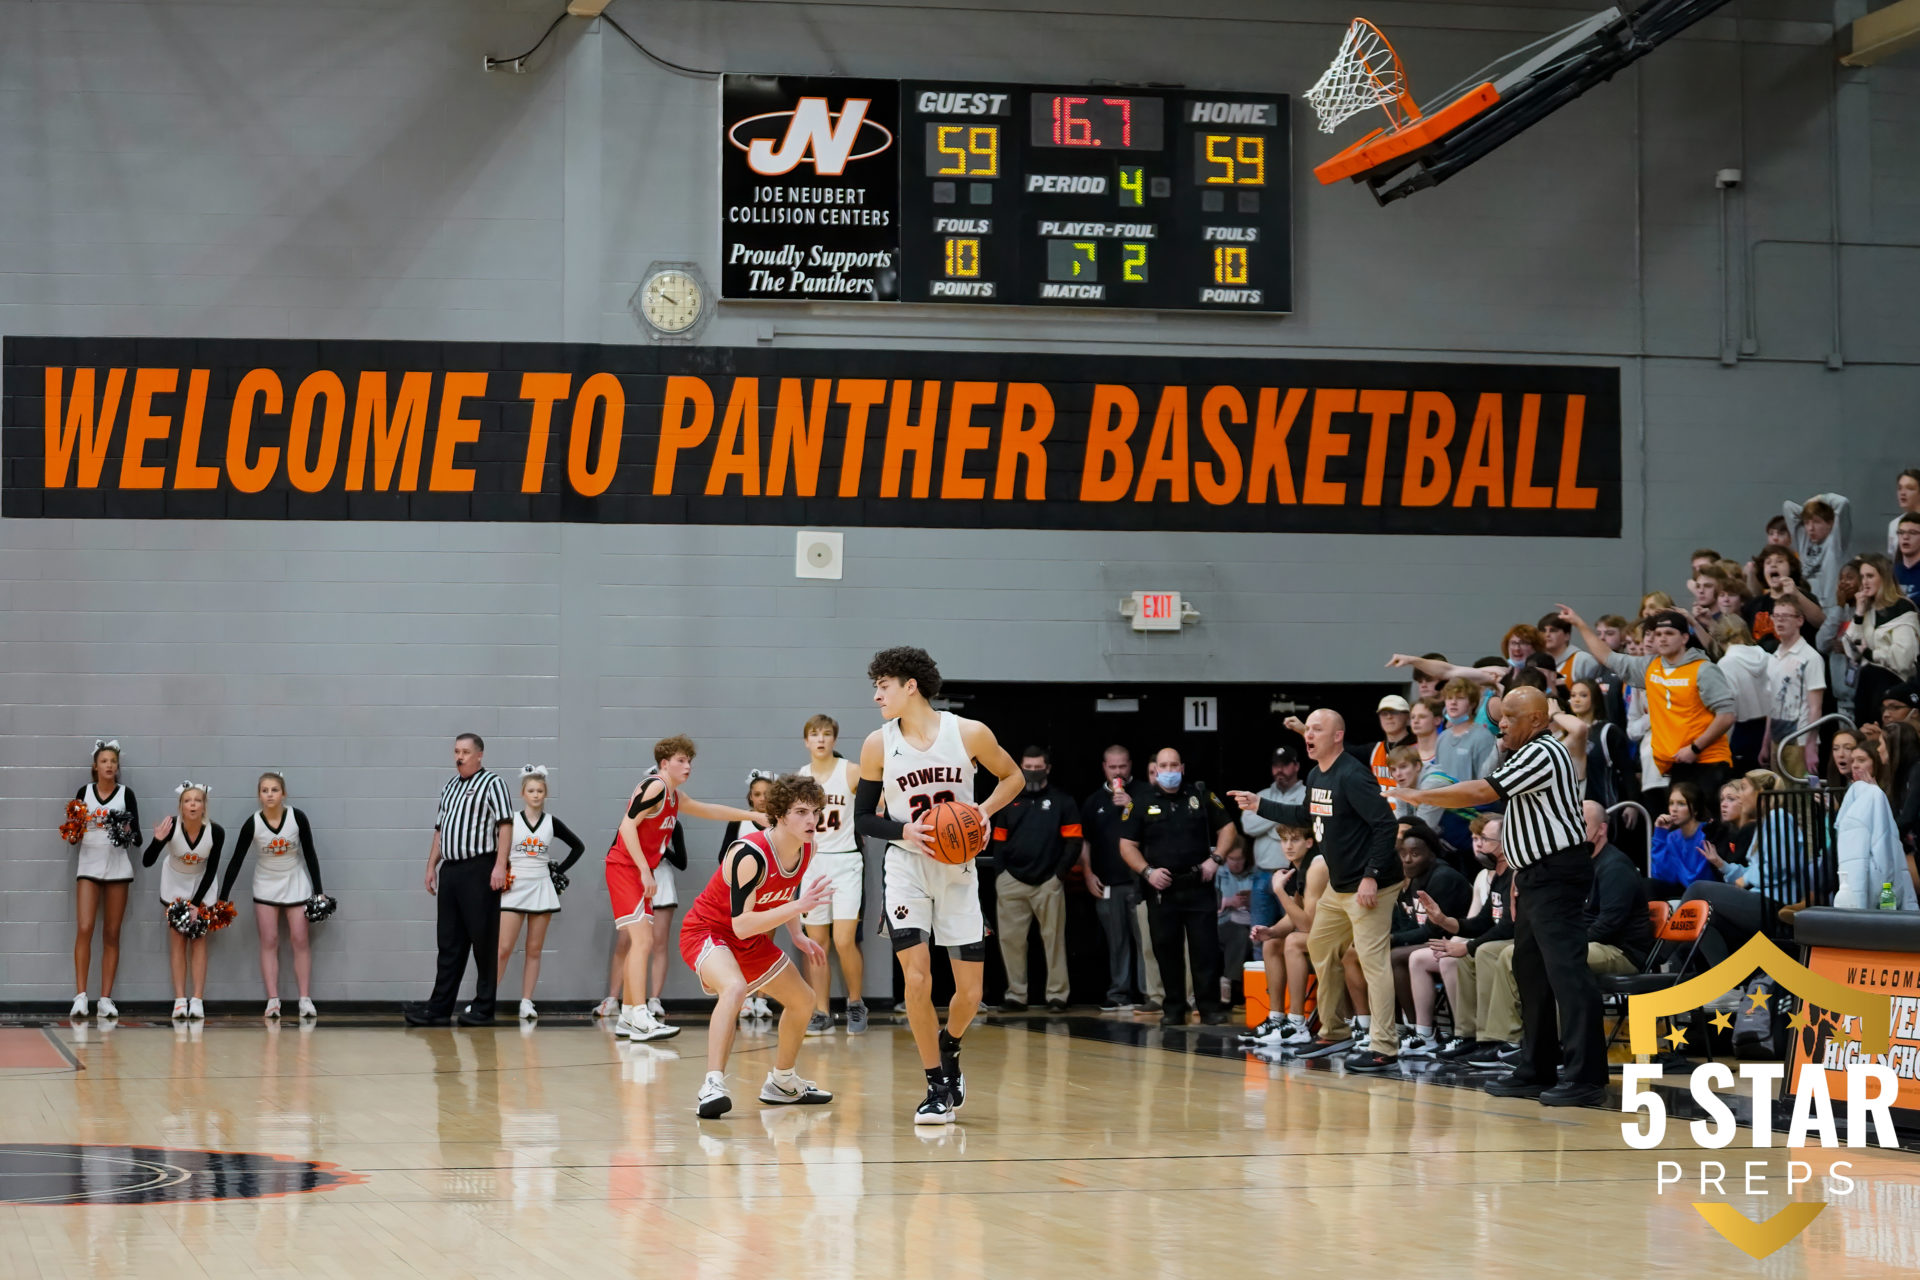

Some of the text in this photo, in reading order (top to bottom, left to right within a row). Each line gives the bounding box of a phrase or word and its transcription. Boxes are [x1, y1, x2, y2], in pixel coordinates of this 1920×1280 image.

[918, 92, 1008, 115] GUEST
[1191, 102, 1269, 124] HOME
[1052, 97, 1131, 147] 16.7
[747, 97, 872, 176] JN
[937, 126, 997, 175] 59
[1206, 135, 1264, 184] 59
[753, 186, 866, 204] JOE NEUBERT
[1028, 176, 1105, 195] PERIOD
[1120, 169, 1143, 205] 4
[729, 206, 890, 226] COLLISION CENTERS
[936, 219, 990, 233] FOULS
[1041, 222, 1155, 238] PLAYER-FOUL
[1204, 227, 1257, 241] FOULS
[729, 243, 892, 273] Proudly Supports
[945, 239, 978, 276] 10
[1123, 244, 1146, 281] 2
[1214, 247, 1247, 284] 10
[749, 270, 874, 293] The Panthers
[933, 282, 994, 297] POINTS
[1043, 284, 1102, 299] MATCH
[1202, 289, 1261, 304] POINTS
[44, 367, 1599, 510] WELCOME TO PANTHER BASKETBALL
[1143, 593, 1175, 619] EXIT
[1192, 700, 1208, 727] 11
[896, 766, 963, 793] POWELL
[827, 794, 846, 806] ELL
